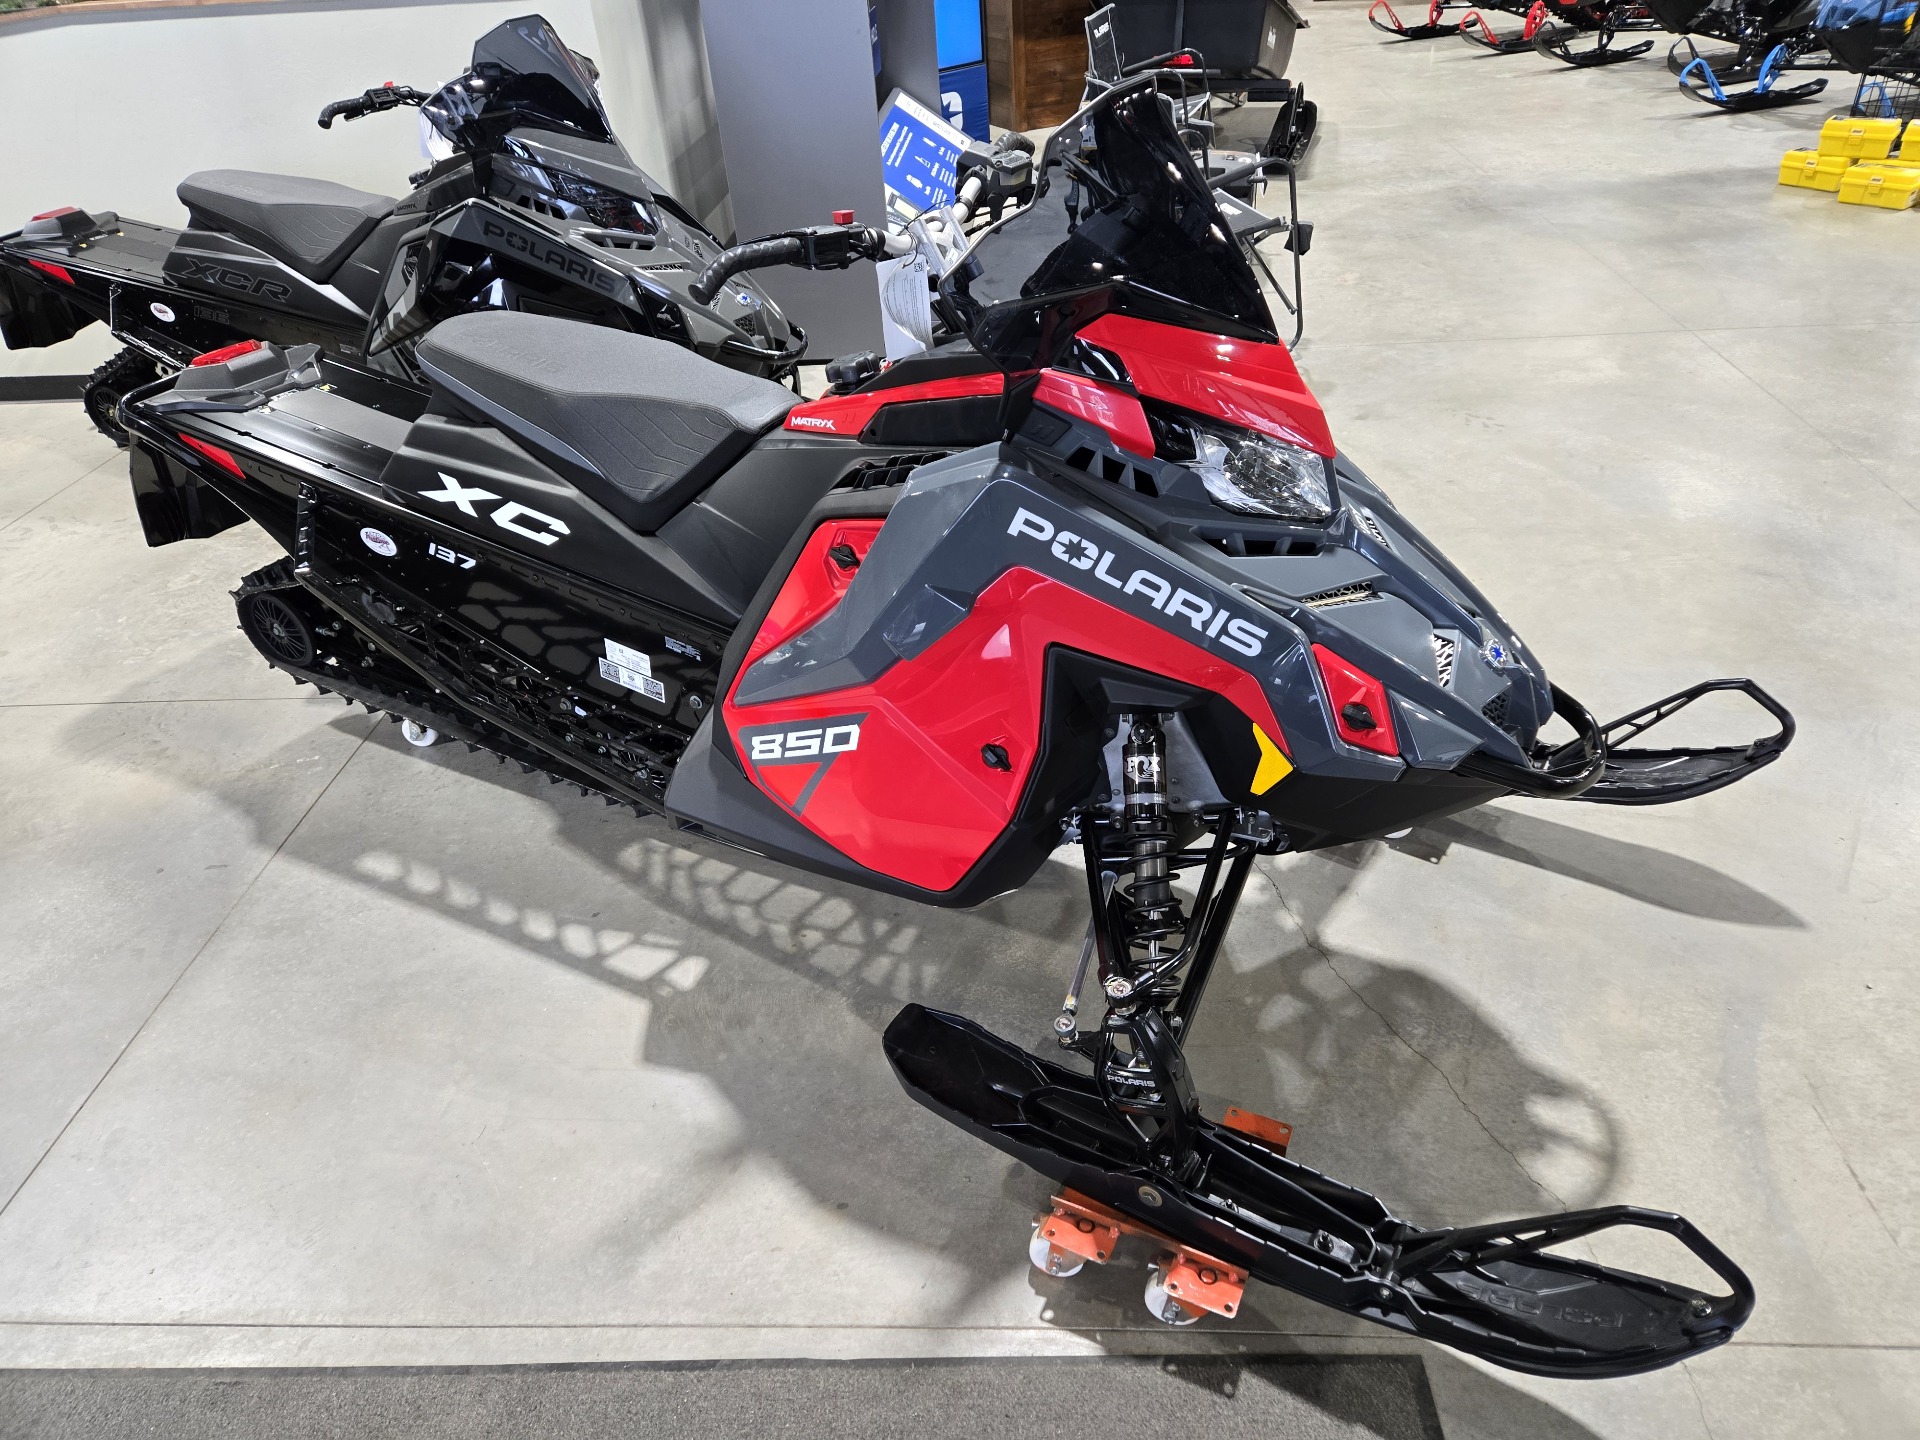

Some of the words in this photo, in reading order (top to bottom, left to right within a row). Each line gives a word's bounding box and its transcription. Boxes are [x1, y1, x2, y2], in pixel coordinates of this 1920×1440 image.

[483, 220, 617, 294] POLARIS
[181, 257, 293, 303] XCR
[791, 416, 837, 431] MATRYX
[417, 471, 572, 546] XC
[428, 542, 477, 570] 137
[1007, 506, 1269, 657] POLARIS
[751, 723, 861, 760] 850
[1126, 755, 1161, 778] FOX
[1106, 1074, 1156, 1088] POLARIS
